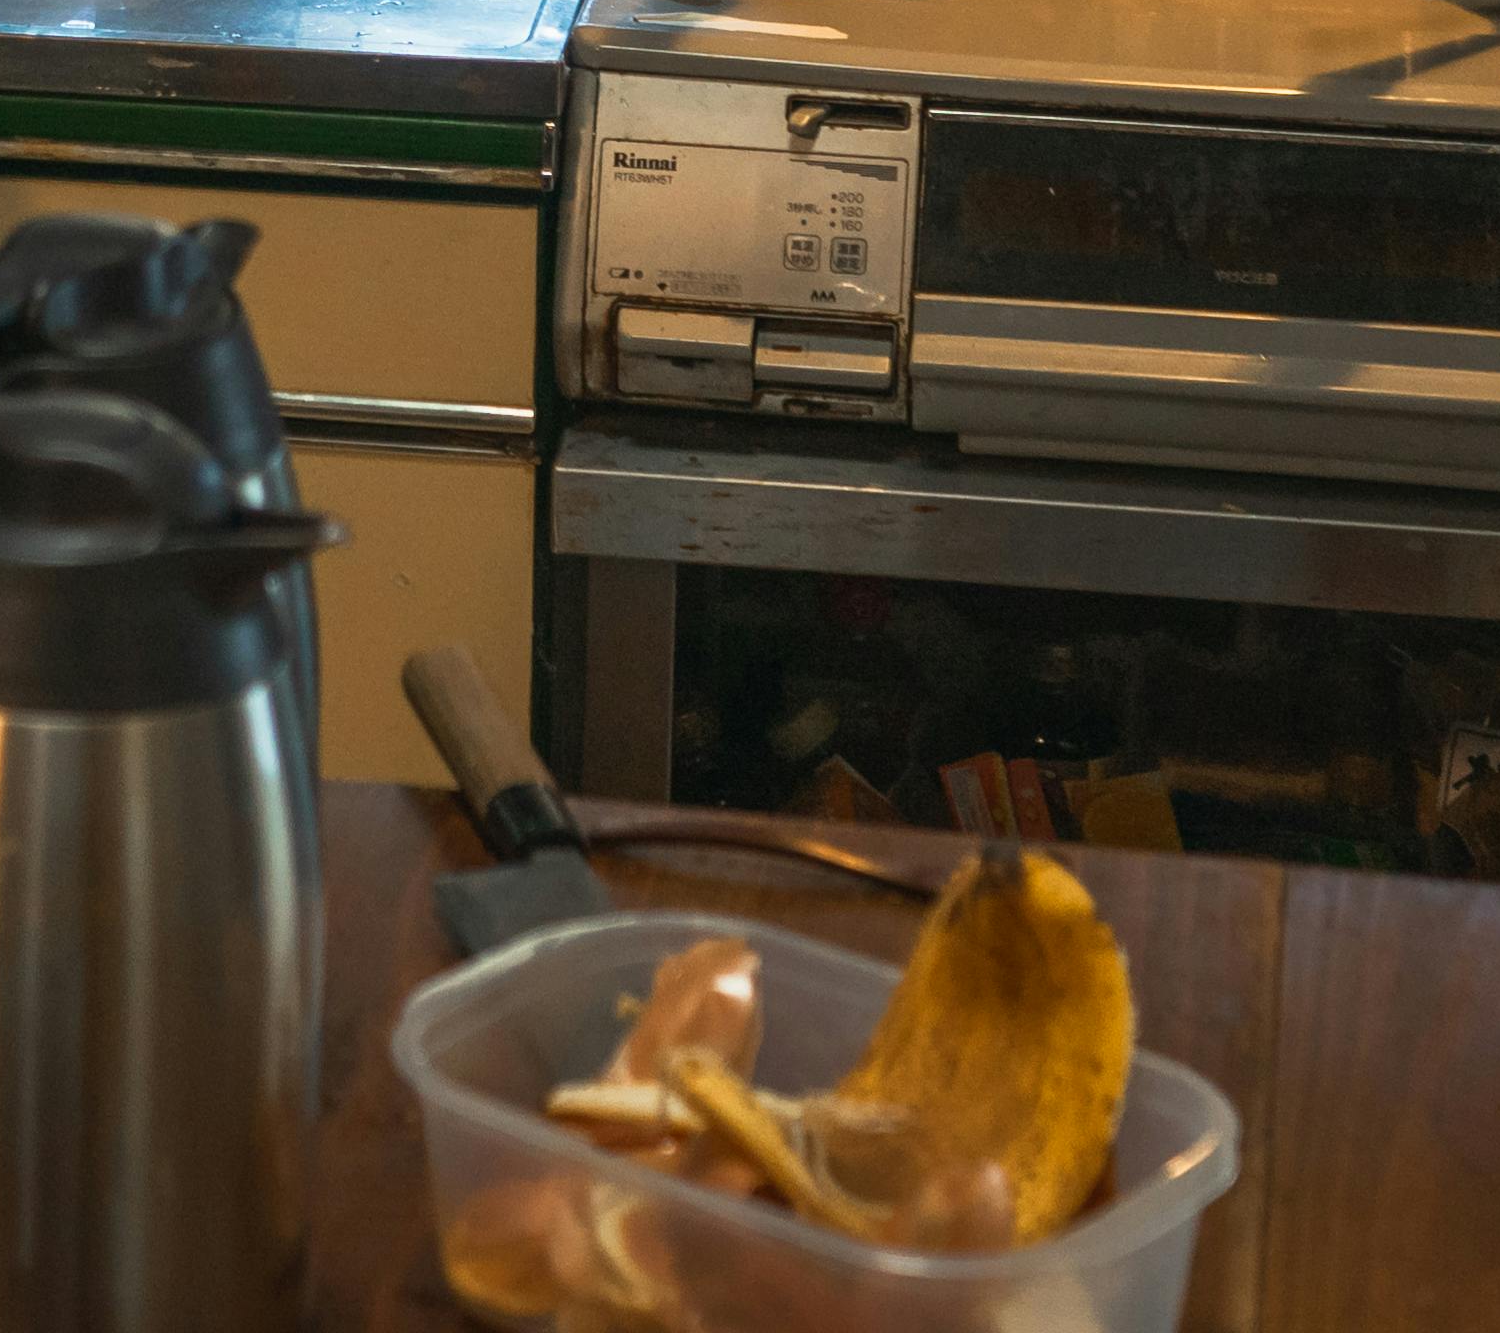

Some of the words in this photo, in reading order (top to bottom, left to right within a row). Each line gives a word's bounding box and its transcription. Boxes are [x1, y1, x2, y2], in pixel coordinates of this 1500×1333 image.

[613, 151, 677, 172] Rinnai
[837, 191, 864, 204] 200
[840, 219, 863, 232] 160
